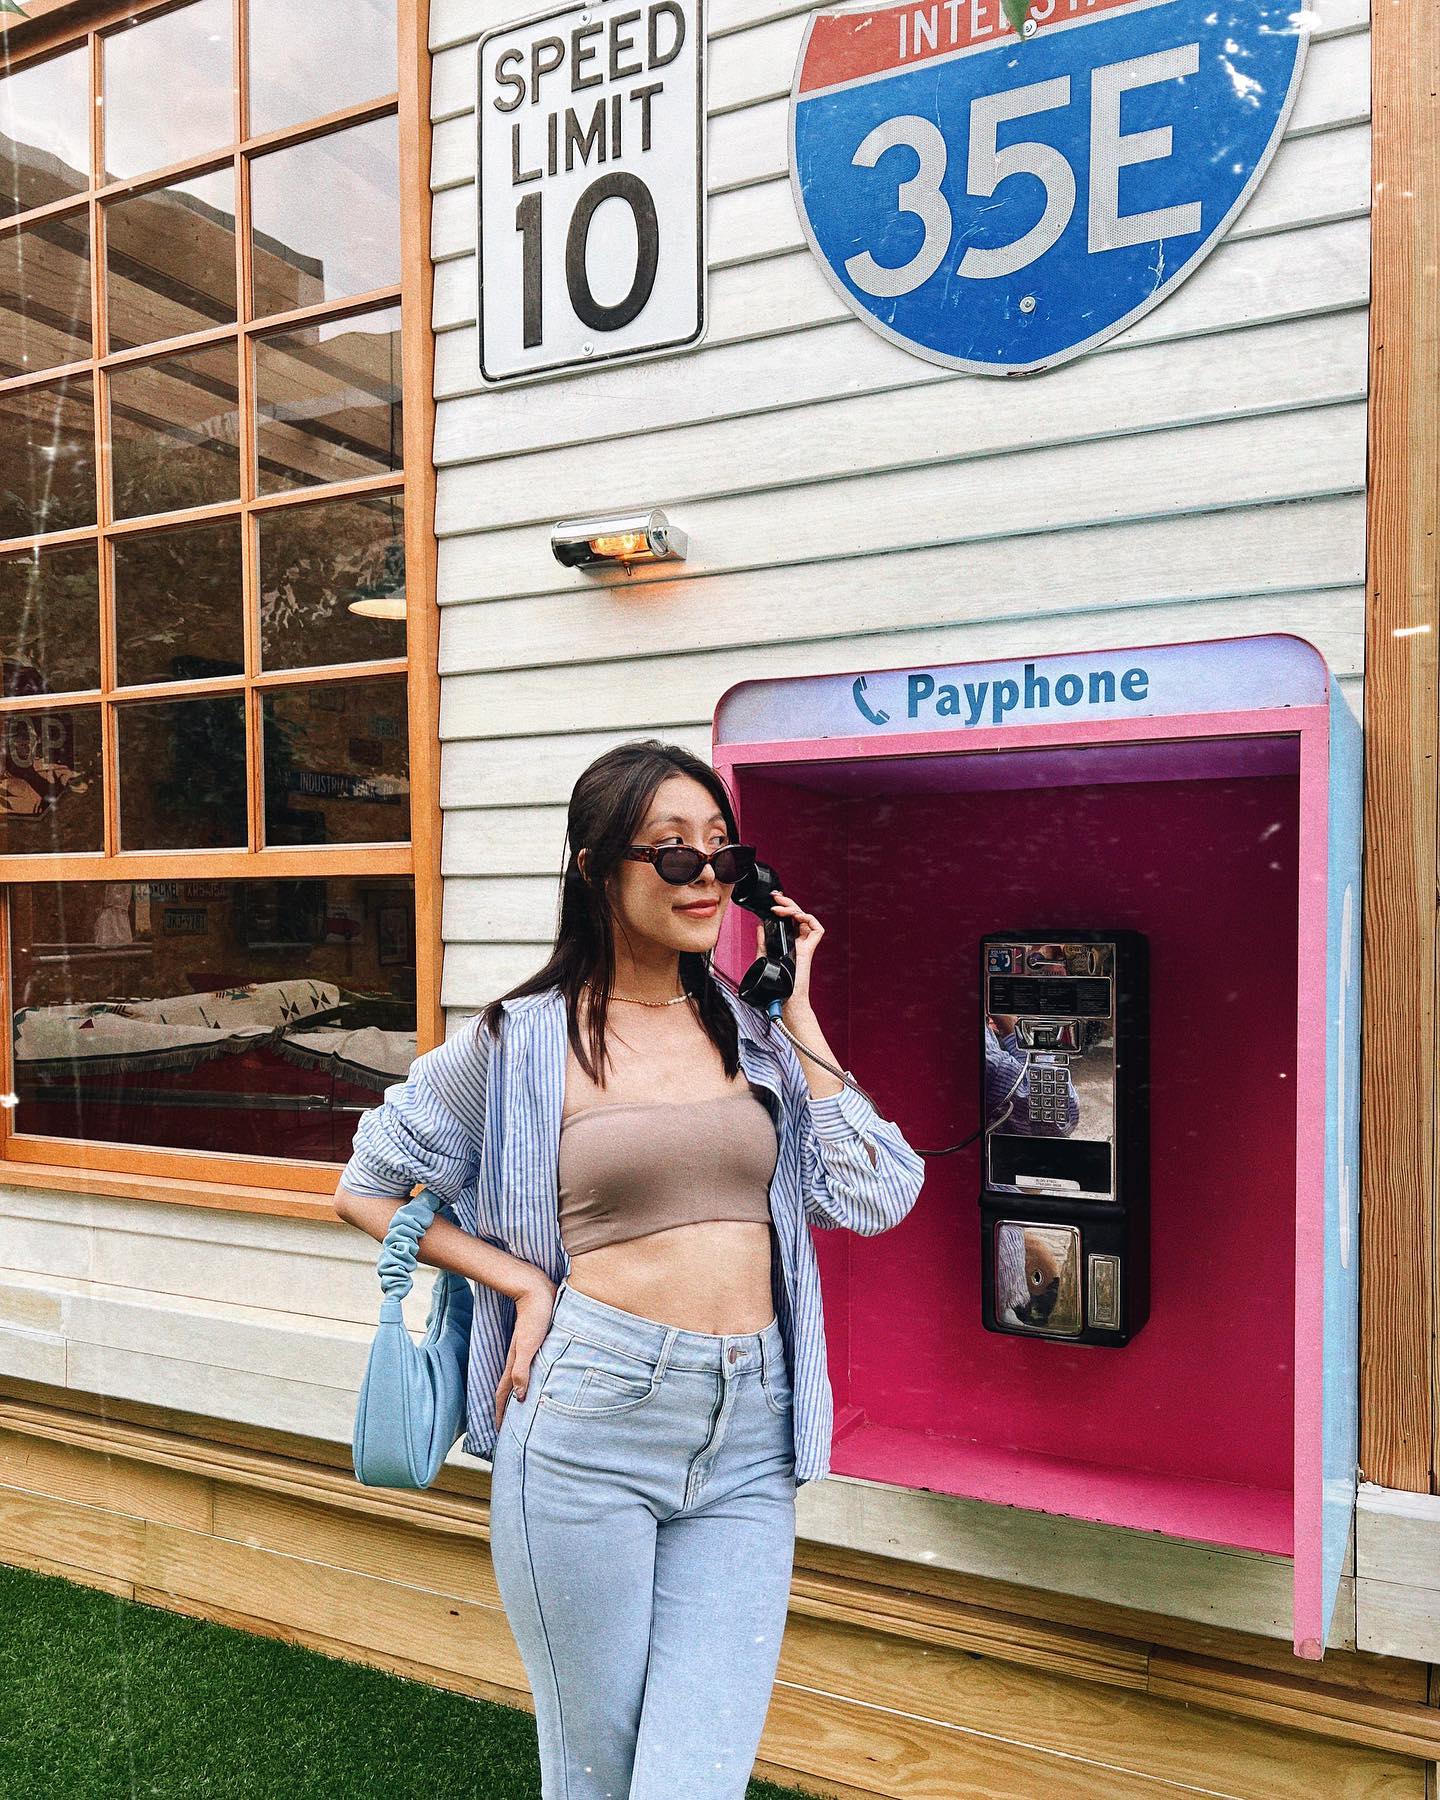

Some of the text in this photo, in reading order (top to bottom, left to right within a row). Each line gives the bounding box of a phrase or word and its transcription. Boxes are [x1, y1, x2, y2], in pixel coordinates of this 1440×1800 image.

[493, 1, 686, 113] SPEED
[899, 0, 1101, 59] INTE
[511, 81, 664, 186] LIMIT
[843, 42, 1202, 298] 35E
[515, 171, 659, 350] 10
[907, 663, 1150, 727] Payphone
